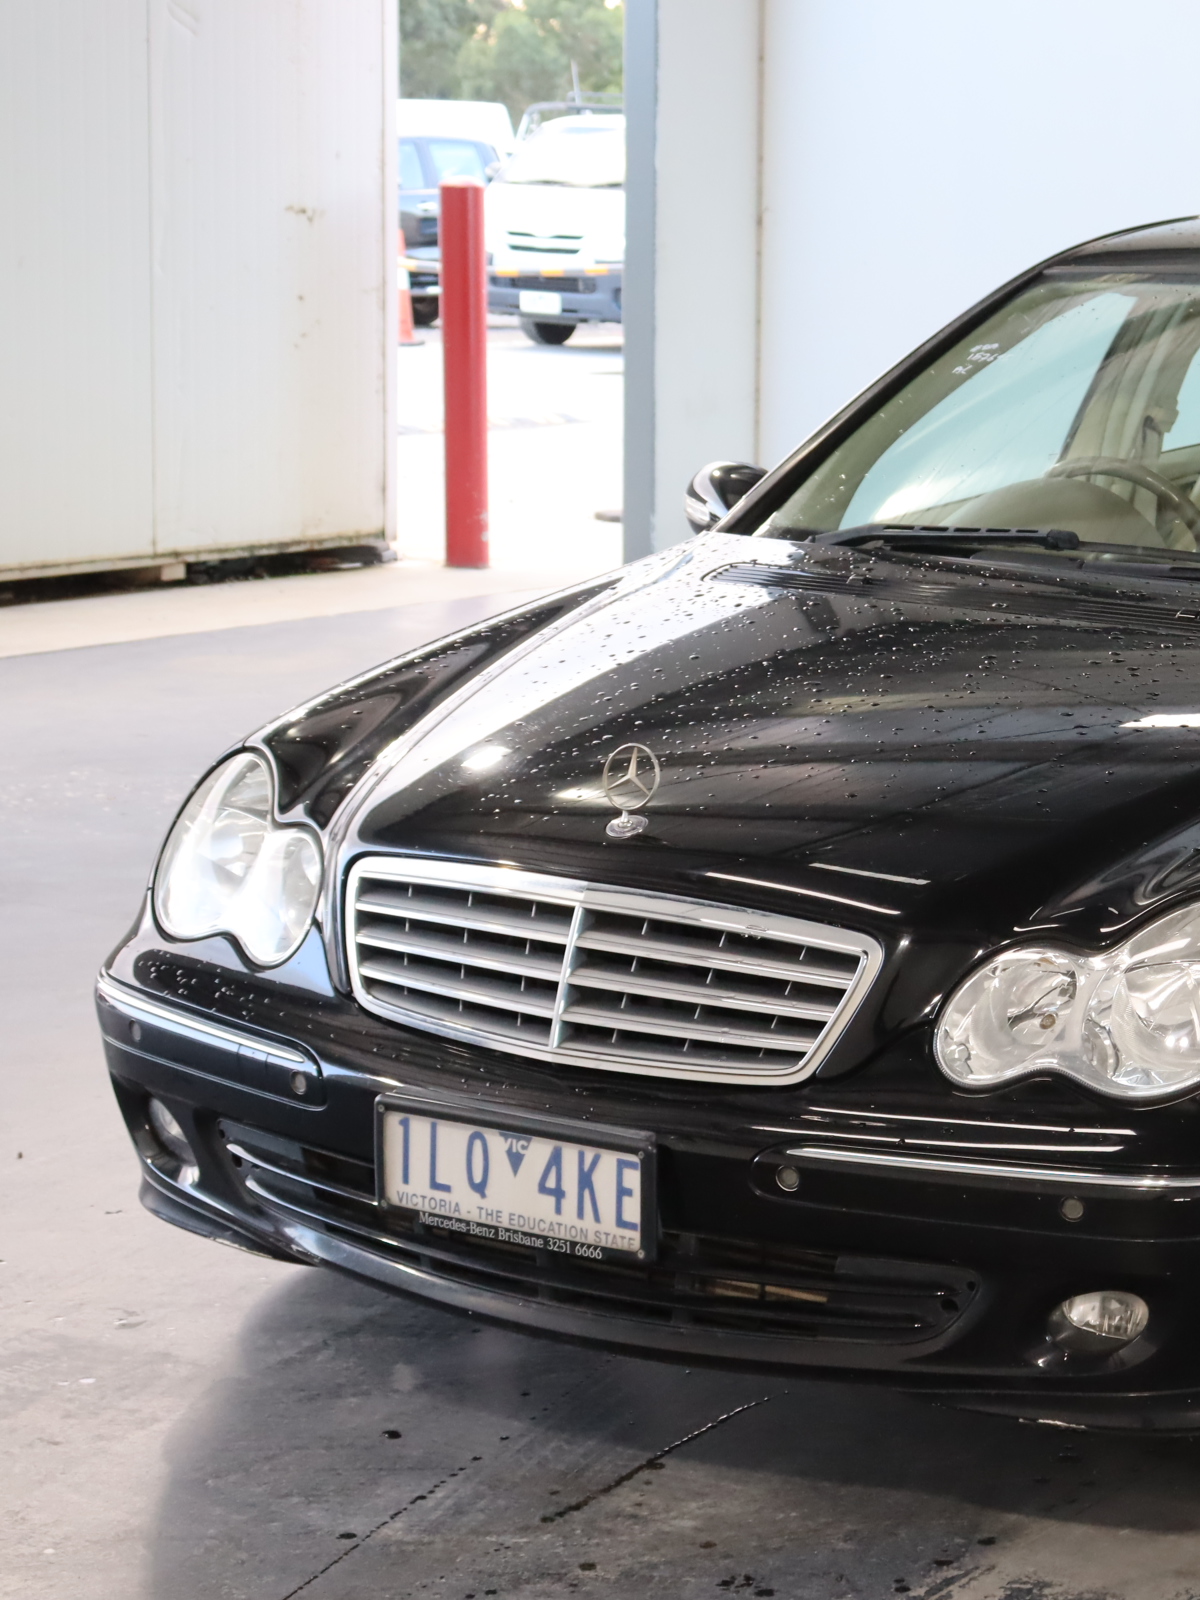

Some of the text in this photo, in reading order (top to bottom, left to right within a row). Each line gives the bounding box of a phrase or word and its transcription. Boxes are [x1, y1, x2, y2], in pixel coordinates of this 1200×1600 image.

[504, 1138, 528, 1155] VIC
[396, 1191, 461, 1216] VICTORIA
[476, 1206, 503, 1225] THE
[508, 1212, 588, 1241] EDUCATION
[593, 1230, 636, 1250] STATE
[418, 1211, 603, 1260] Mercedes-Benz Brisbane 3251 6666
